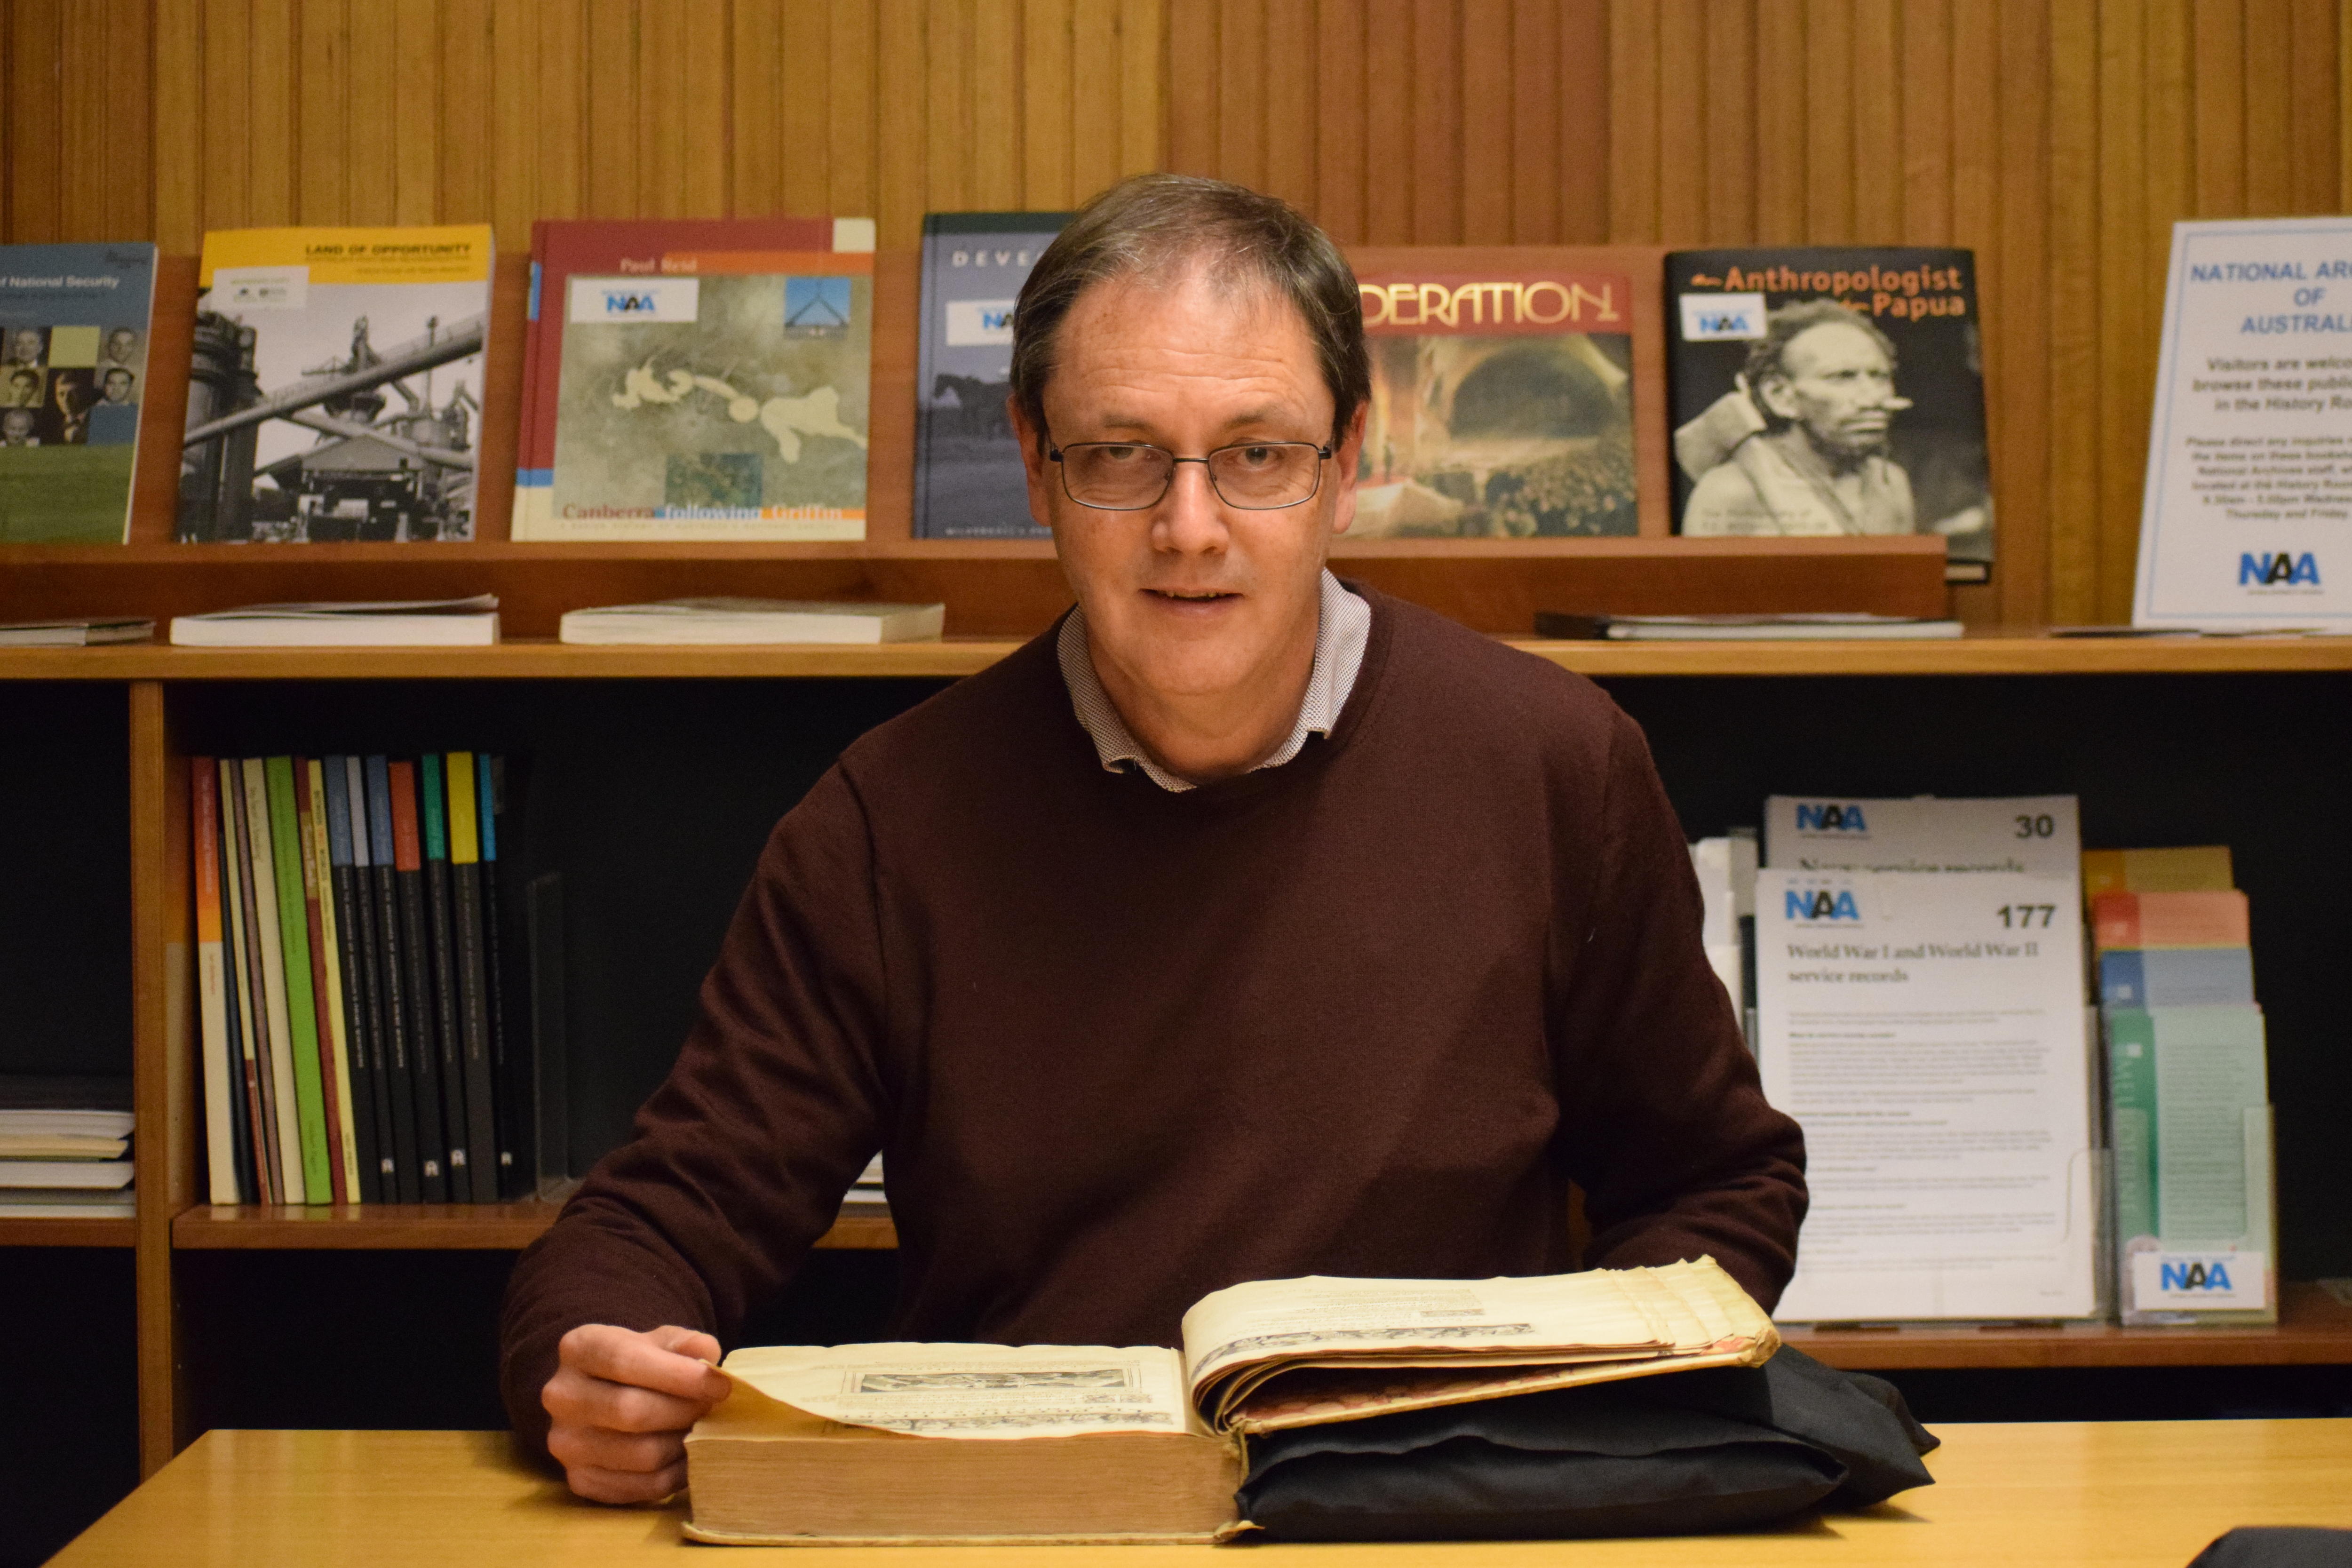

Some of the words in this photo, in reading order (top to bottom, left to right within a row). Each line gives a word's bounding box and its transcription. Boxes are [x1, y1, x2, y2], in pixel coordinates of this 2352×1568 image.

[306, 244, 343, 255] LAND
[349, 244, 366, 254] OF
[372, 243, 470, 254] OPPORTUNITY
[620, 258, 656, 273] Paul
[661, 257, 697, 273] Reid
[2191, 262, 2307, 281] NATIONAL
[2315, 259, 2352, 279] AR
[9, 276, 64, 287] National
[66, 275, 120, 289] Security
[1724, 264, 1964, 297] Anthropologist
[606, 294, 656, 313] NAA
[1360, 282, 1620, 327] DERATION
[1872, 292, 1965, 323] Papua
[2294, 287, 2326, 307] OF
[983, 313, 1014, 329] NA
[1700, 316, 1749, 333] NAA
[562, 504, 654, 519] Canberra
[2239, 551, 2321, 586] NAA
[1796, 804, 1867, 831] NAA
[2015, 814, 2055, 839] 30
[1786, 890, 1859, 920] NAA
[1998, 904, 2057, 928] 177
[1787, 944, 1840, 959] World
[1843, 944, 1878, 959] War
[1894, 944, 1924, 958] and
[1927, 943, 1981, 958] World
[1985, 942, 2020, 957] War
[1789, 969, 1843, 983] service
[1849, 967, 1908, 982] records
[2115, 1060, 2137, 1214] MELOURNE
[2161, 1263, 2233, 1290] NAA
